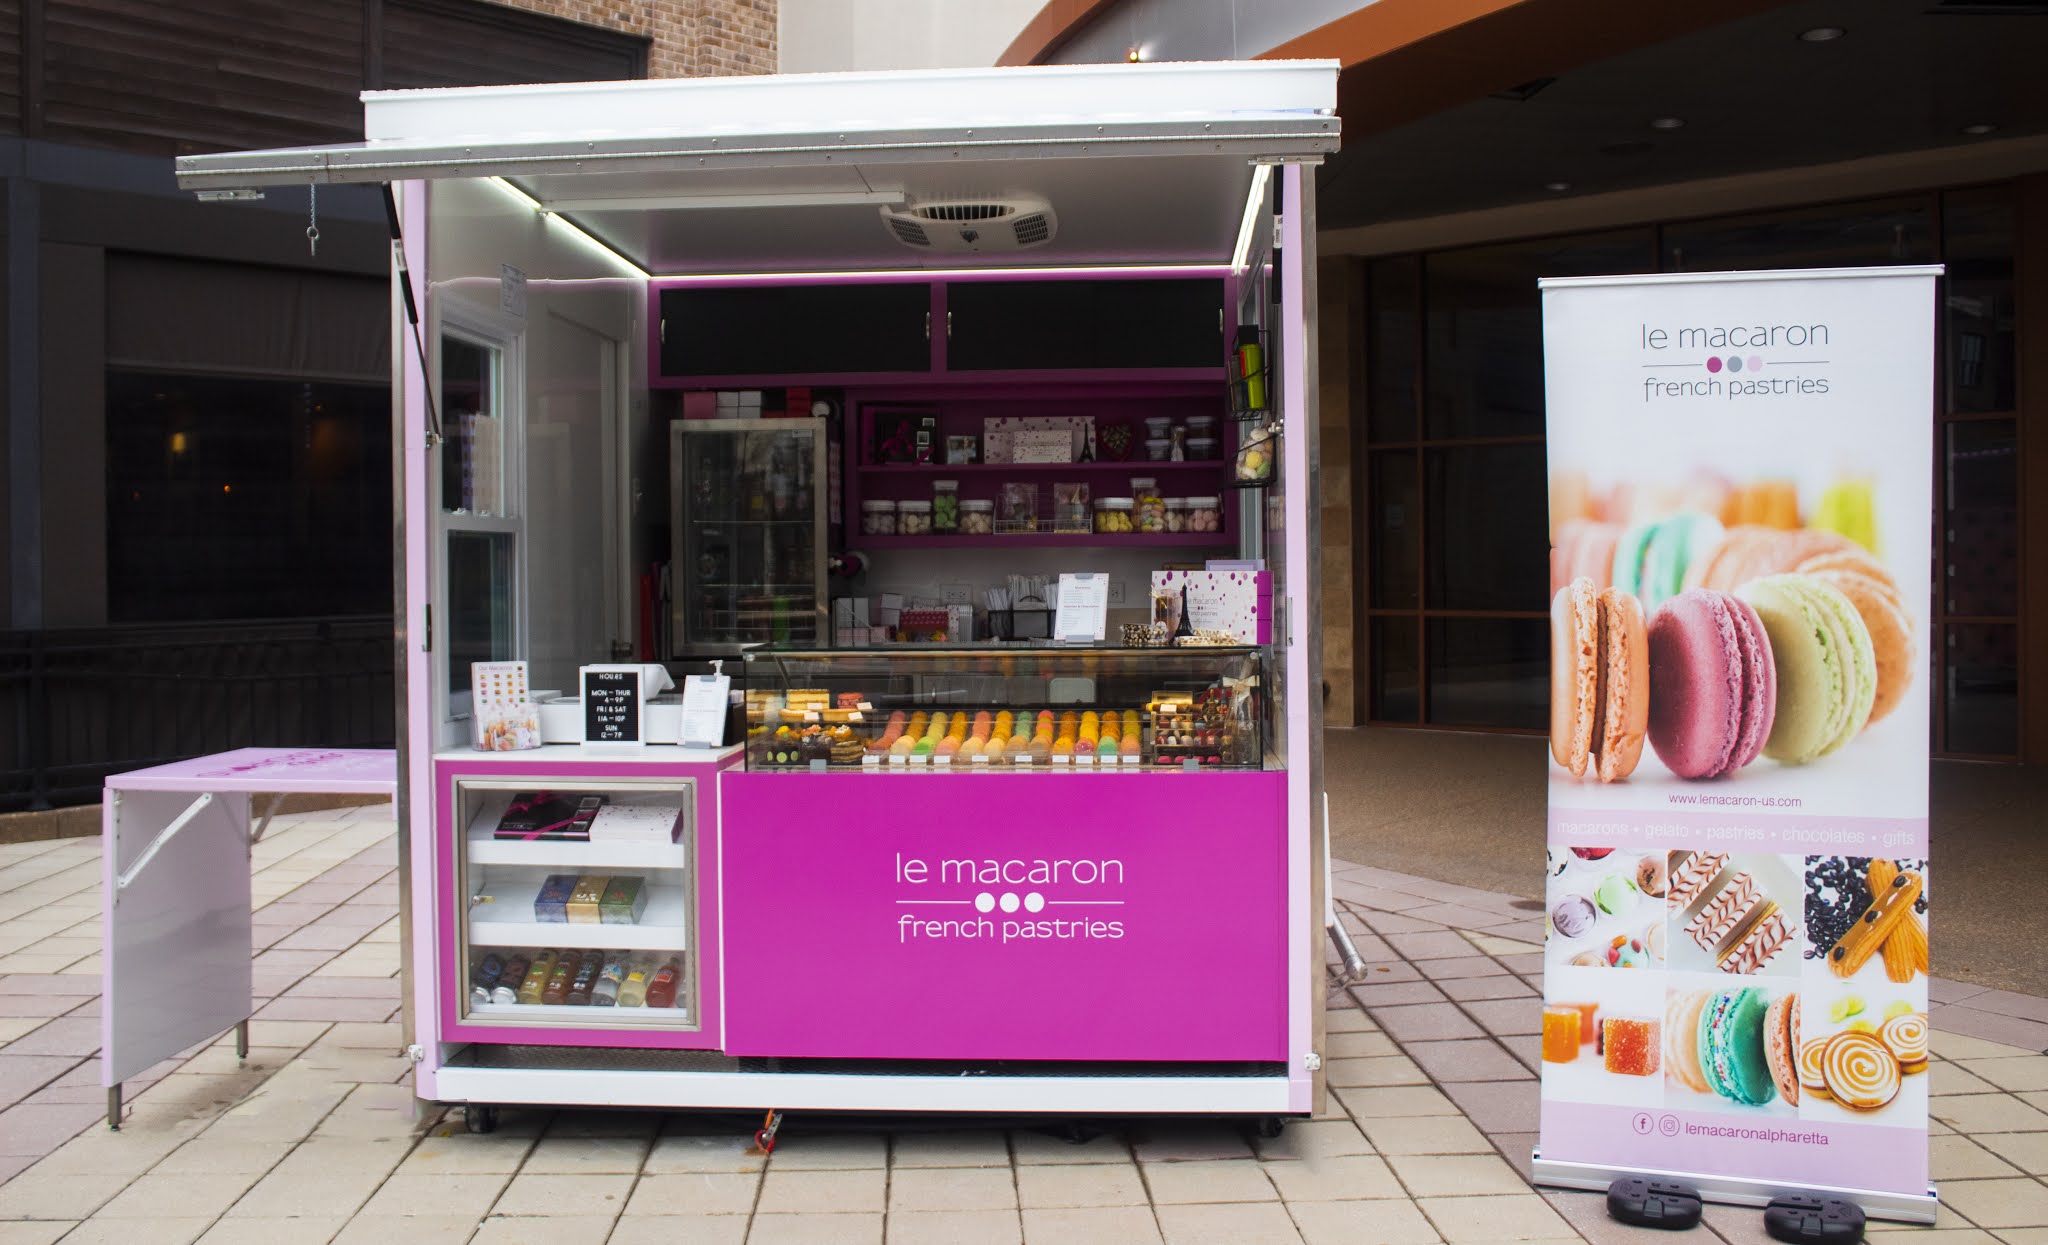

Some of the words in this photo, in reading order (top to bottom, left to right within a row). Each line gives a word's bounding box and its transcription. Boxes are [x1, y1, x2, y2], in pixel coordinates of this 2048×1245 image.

[1642, 322, 1669, 350] le
[1678, 324, 1829, 349] macaron
[1643, 376, 1722, 402] french
[1728, 375, 1830, 401] pastries
[604, 724, 618, 732] SUN
[1669, 793, 1802, 808] www.lemacaron-us.com
[1557, 822, 1629, 835] macarons
[1645, 823, 1689, 839] gelato
[1706, 825, 1765, 842] pastries
[1782, 828, 1865, 844] chocolates
[1882, 831, 1916, 848] gifts
[896, 852, 928, 884] le
[941, 859, 1124, 884] macaron
[897, 914, 994, 944] french
[1002, 916, 1124, 944] pastries
[1685, 1121, 1829, 1145] lemacaronalpharetta
